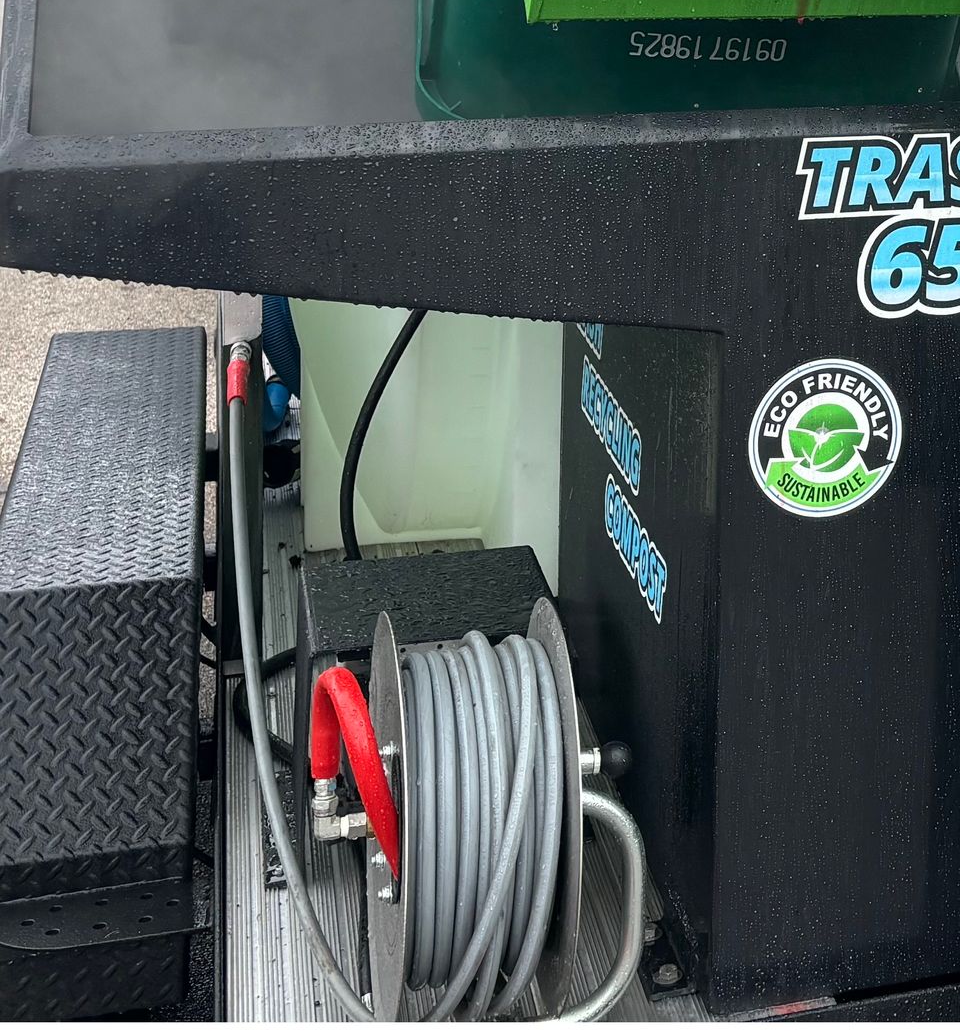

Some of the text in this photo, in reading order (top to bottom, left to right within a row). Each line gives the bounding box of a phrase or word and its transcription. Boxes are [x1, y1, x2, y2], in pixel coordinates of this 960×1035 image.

[583, 357, 641, 494] RECYCLING
[763, 373, 889, 441] ECO FRIENDLY
[777, 472, 866, 503] SUSTAINABLE
[606, 475, 666, 622] COMPOST
